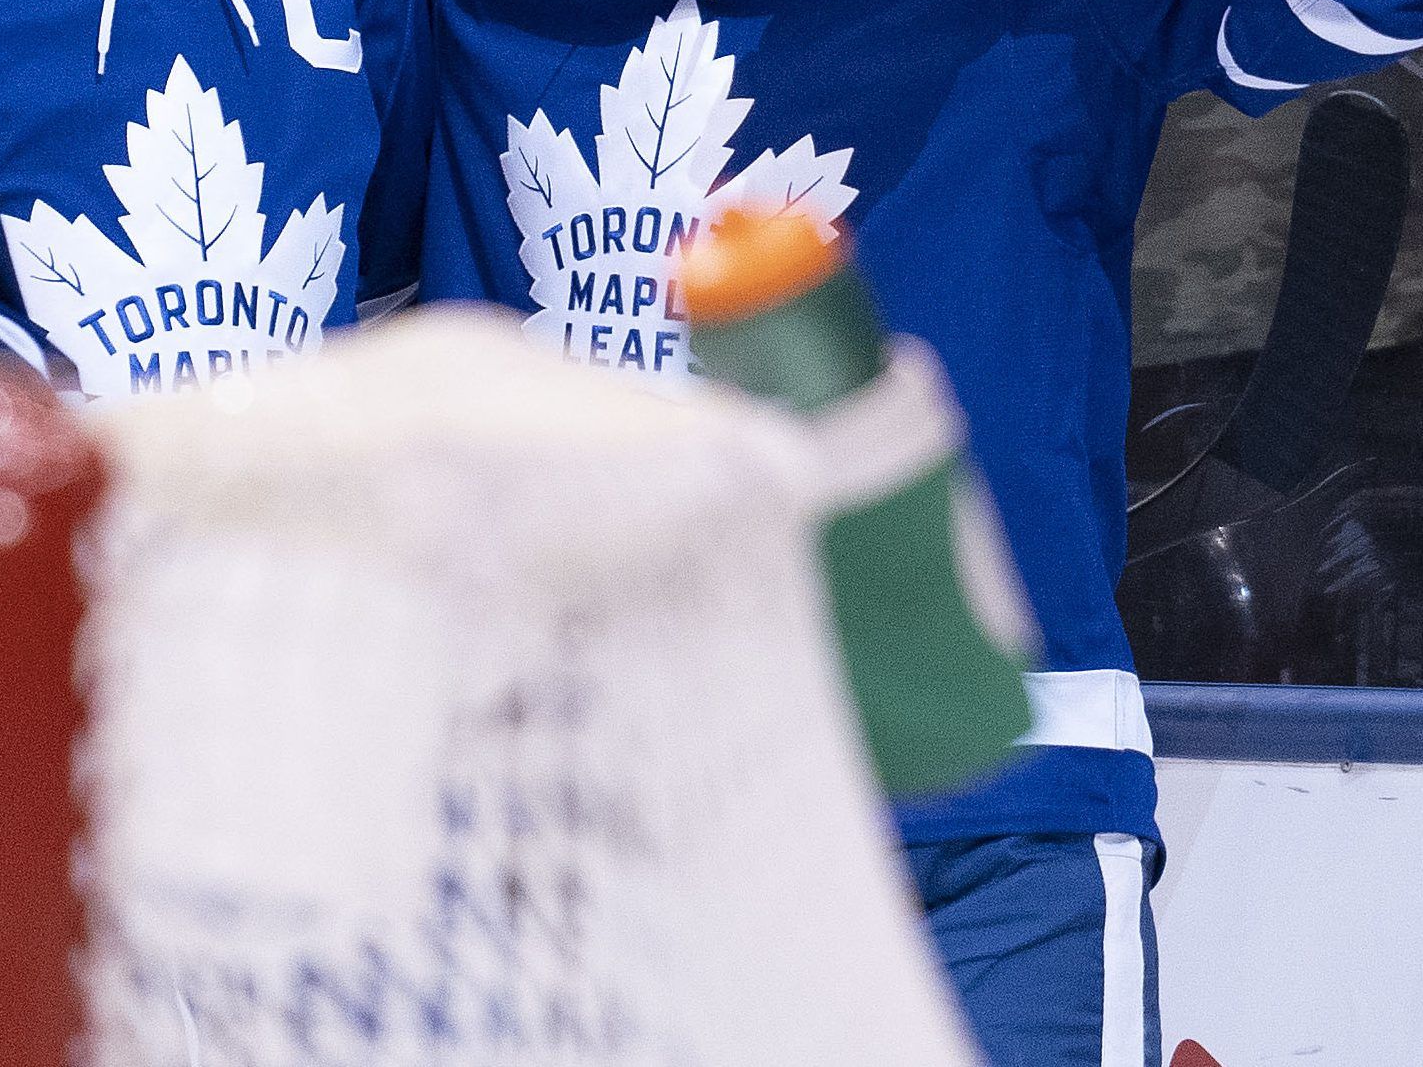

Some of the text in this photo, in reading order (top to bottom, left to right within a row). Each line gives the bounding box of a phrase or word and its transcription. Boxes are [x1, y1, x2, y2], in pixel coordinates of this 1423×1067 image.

[542, 206, 700, 271] TORON
[78, 279, 309, 356] TORONTO
[567, 270, 686, 322] MAPL
[128, 348, 285, 395] MAP
[562, 322, 682, 372] LEAF
